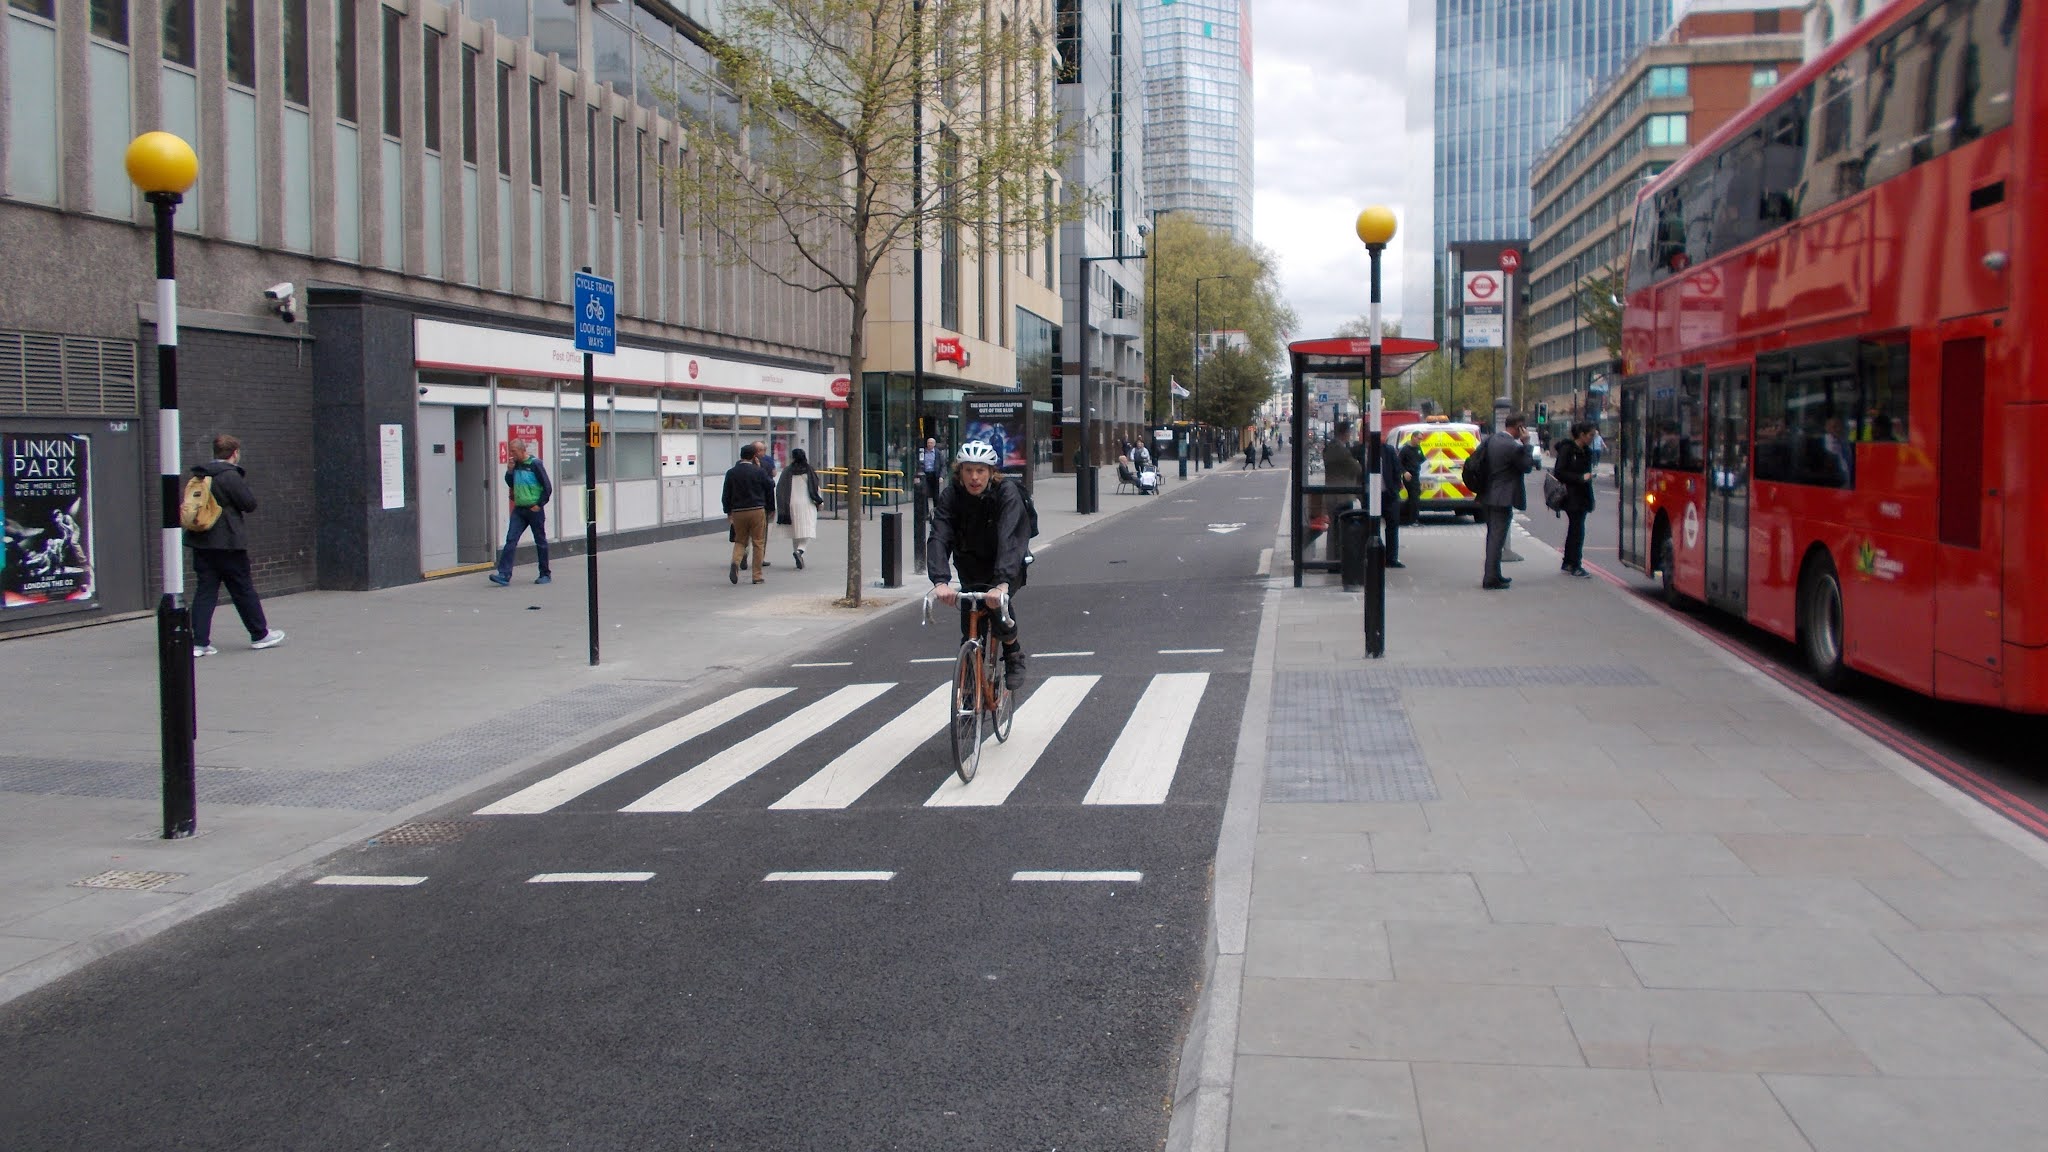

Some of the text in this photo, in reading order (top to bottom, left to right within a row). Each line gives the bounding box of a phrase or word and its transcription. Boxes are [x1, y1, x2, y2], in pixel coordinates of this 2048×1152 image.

[1502, 255, 1517, 266] SA
[576, 277, 614, 296] CYCLE TRACK
[580, 322, 612, 337] LOOK BOTH
[588, 336, 604, 348] WAYS
[938, 343, 956, 354] ibis
[553, 350, 581, 364] Post Office
[516, 425, 526, 434] Free
[13, 439, 75, 458] LINKIN
[14, 458, 76, 477] PARK
[23, 582, 50, 590] LONDON
